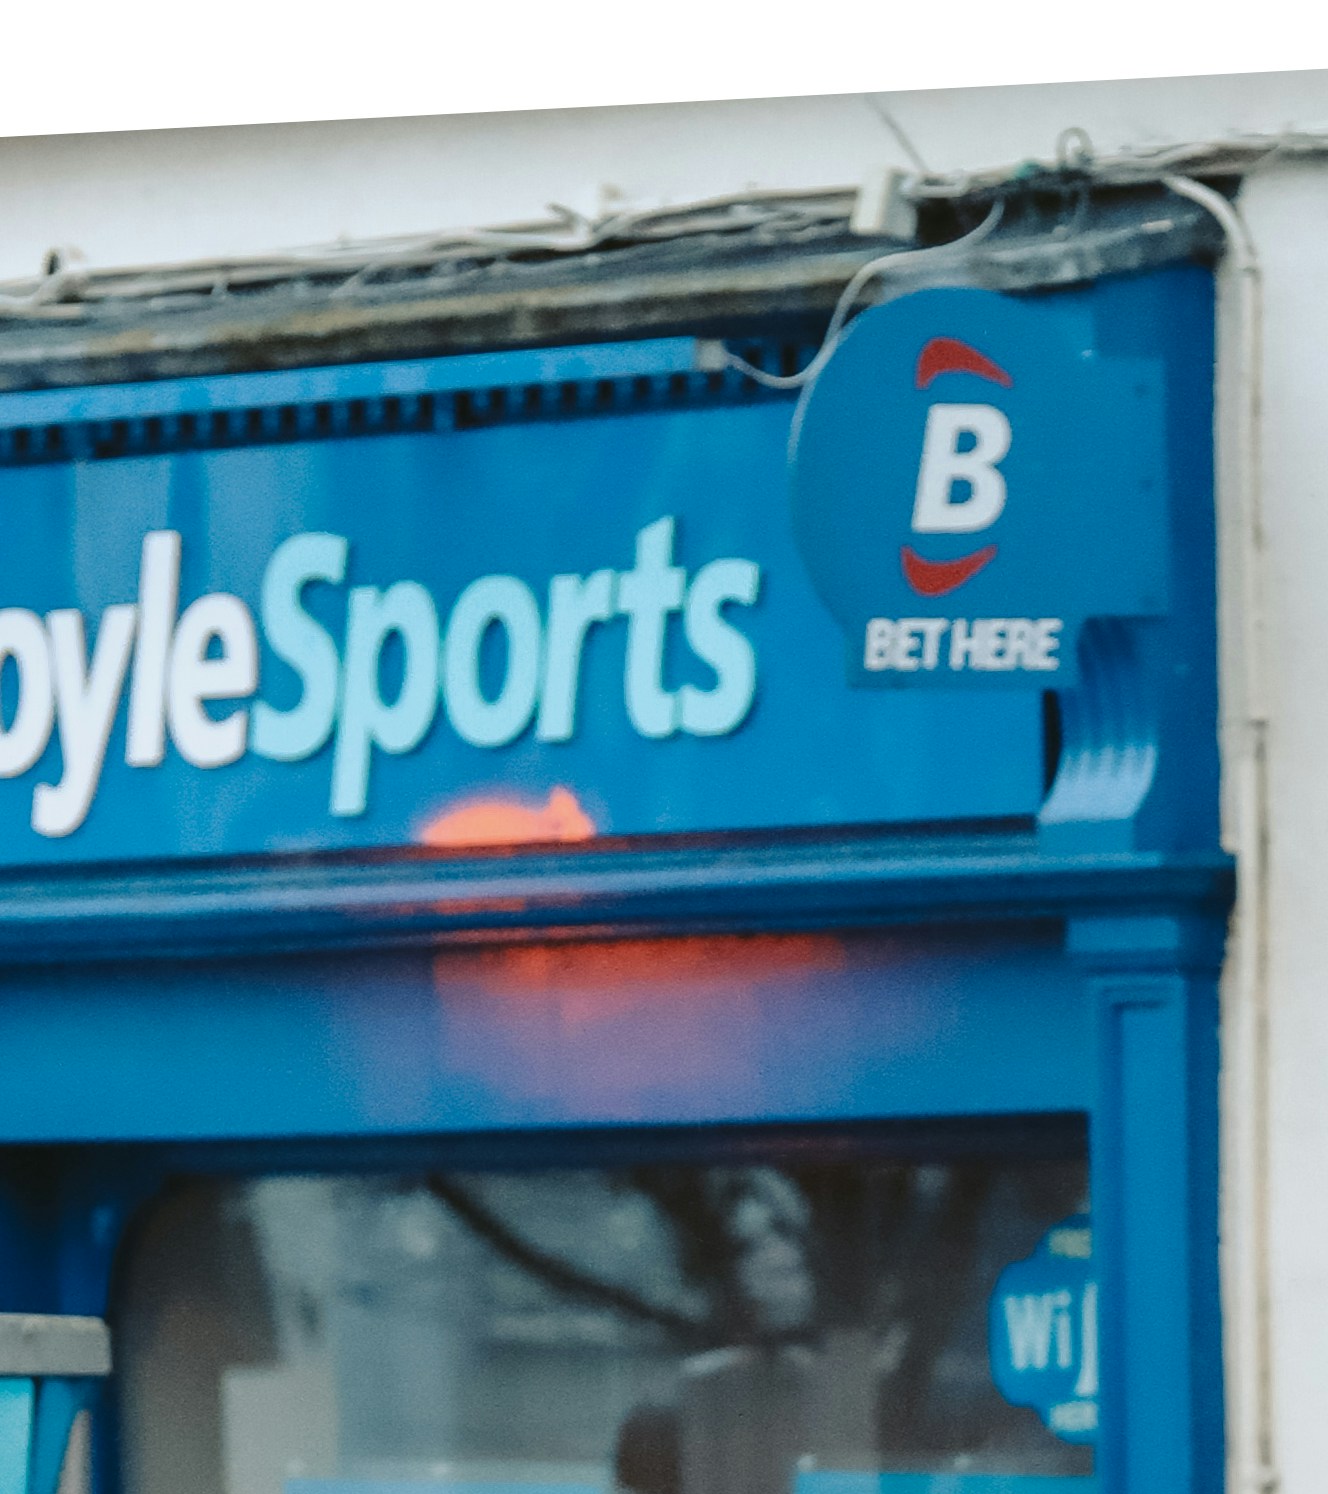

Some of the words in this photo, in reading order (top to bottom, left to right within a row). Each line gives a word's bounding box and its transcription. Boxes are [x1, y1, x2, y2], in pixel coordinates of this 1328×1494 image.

[909, 402, 1014, 534] B
[864, 617, 949, 671] BET
[950, 617, 1063, 671] HERE
